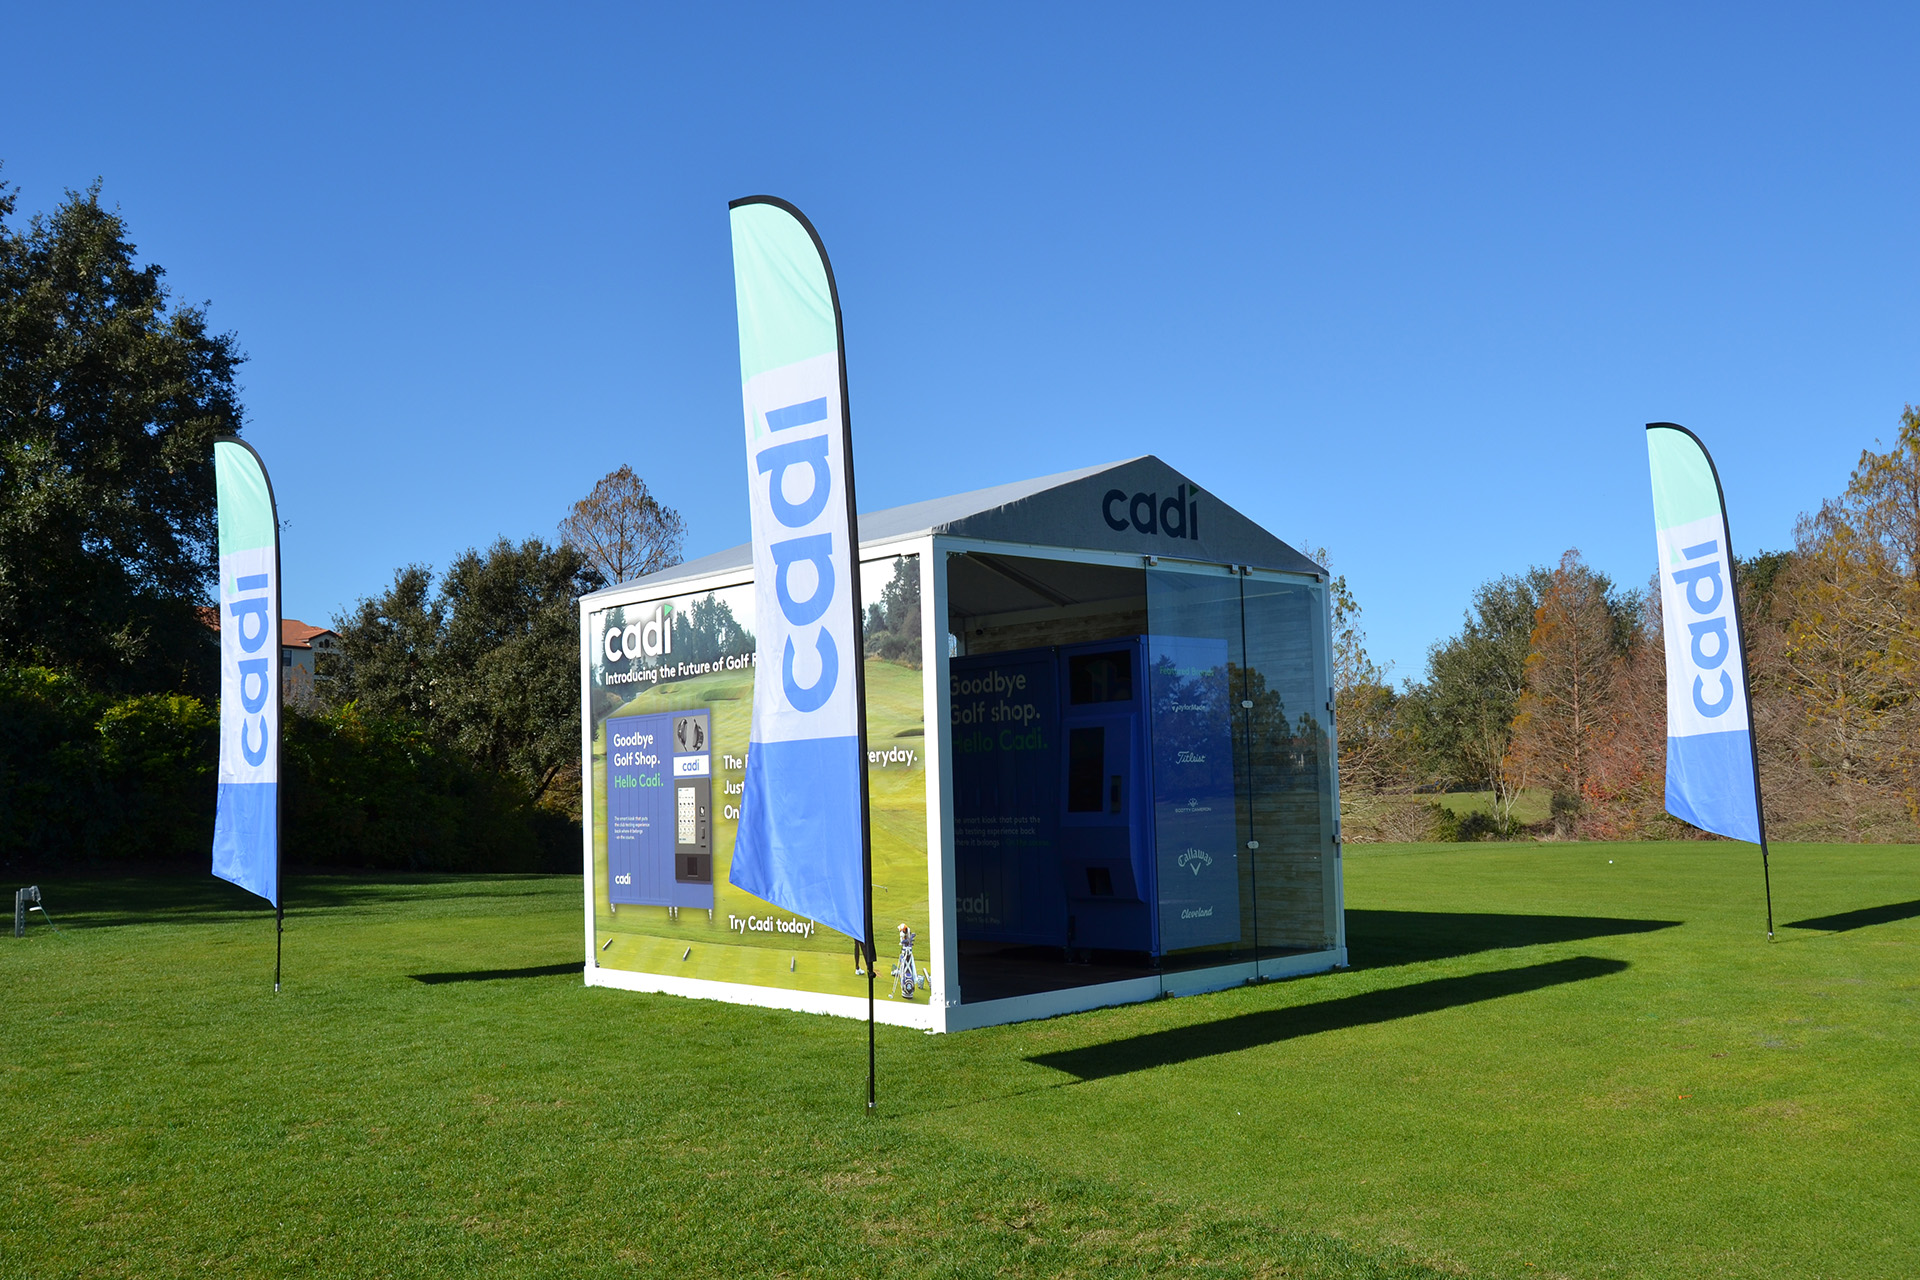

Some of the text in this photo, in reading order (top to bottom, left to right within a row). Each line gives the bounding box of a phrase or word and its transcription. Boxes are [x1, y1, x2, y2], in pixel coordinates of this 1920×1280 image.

[1102, 483, 1199, 541] cadi
[752, 396, 839, 713] cadi
[604, 604, 673, 662] cadi
[1670, 539, 1734, 719] cadi
[228, 573, 269, 767] cadi
[605, 667, 658, 685] Introducing
[659, 663, 676, 679] the
[678, 662, 710, 677] Future
[712, 658, 725, 671] of
[726, 653, 750, 671] Golf
[950, 670, 1027, 698] Goodbye
[951, 699, 1041, 727] Golf shop.
[613, 731, 654, 749] Goodbye
[613, 751, 661, 768] Golf Shop.
[682, 760, 700, 772] cadi
[723, 754, 743, 770] The
[867, 746, 918, 768] eryday.
[614, 773, 664, 788] Hello Cadi.
[1177, 847, 1213, 867] Callaway
[614, 872, 631, 885] cadi
[1181, 906, 1213, 920] Cleveland
[728, 914, 815, 939] Try Cadi today!
